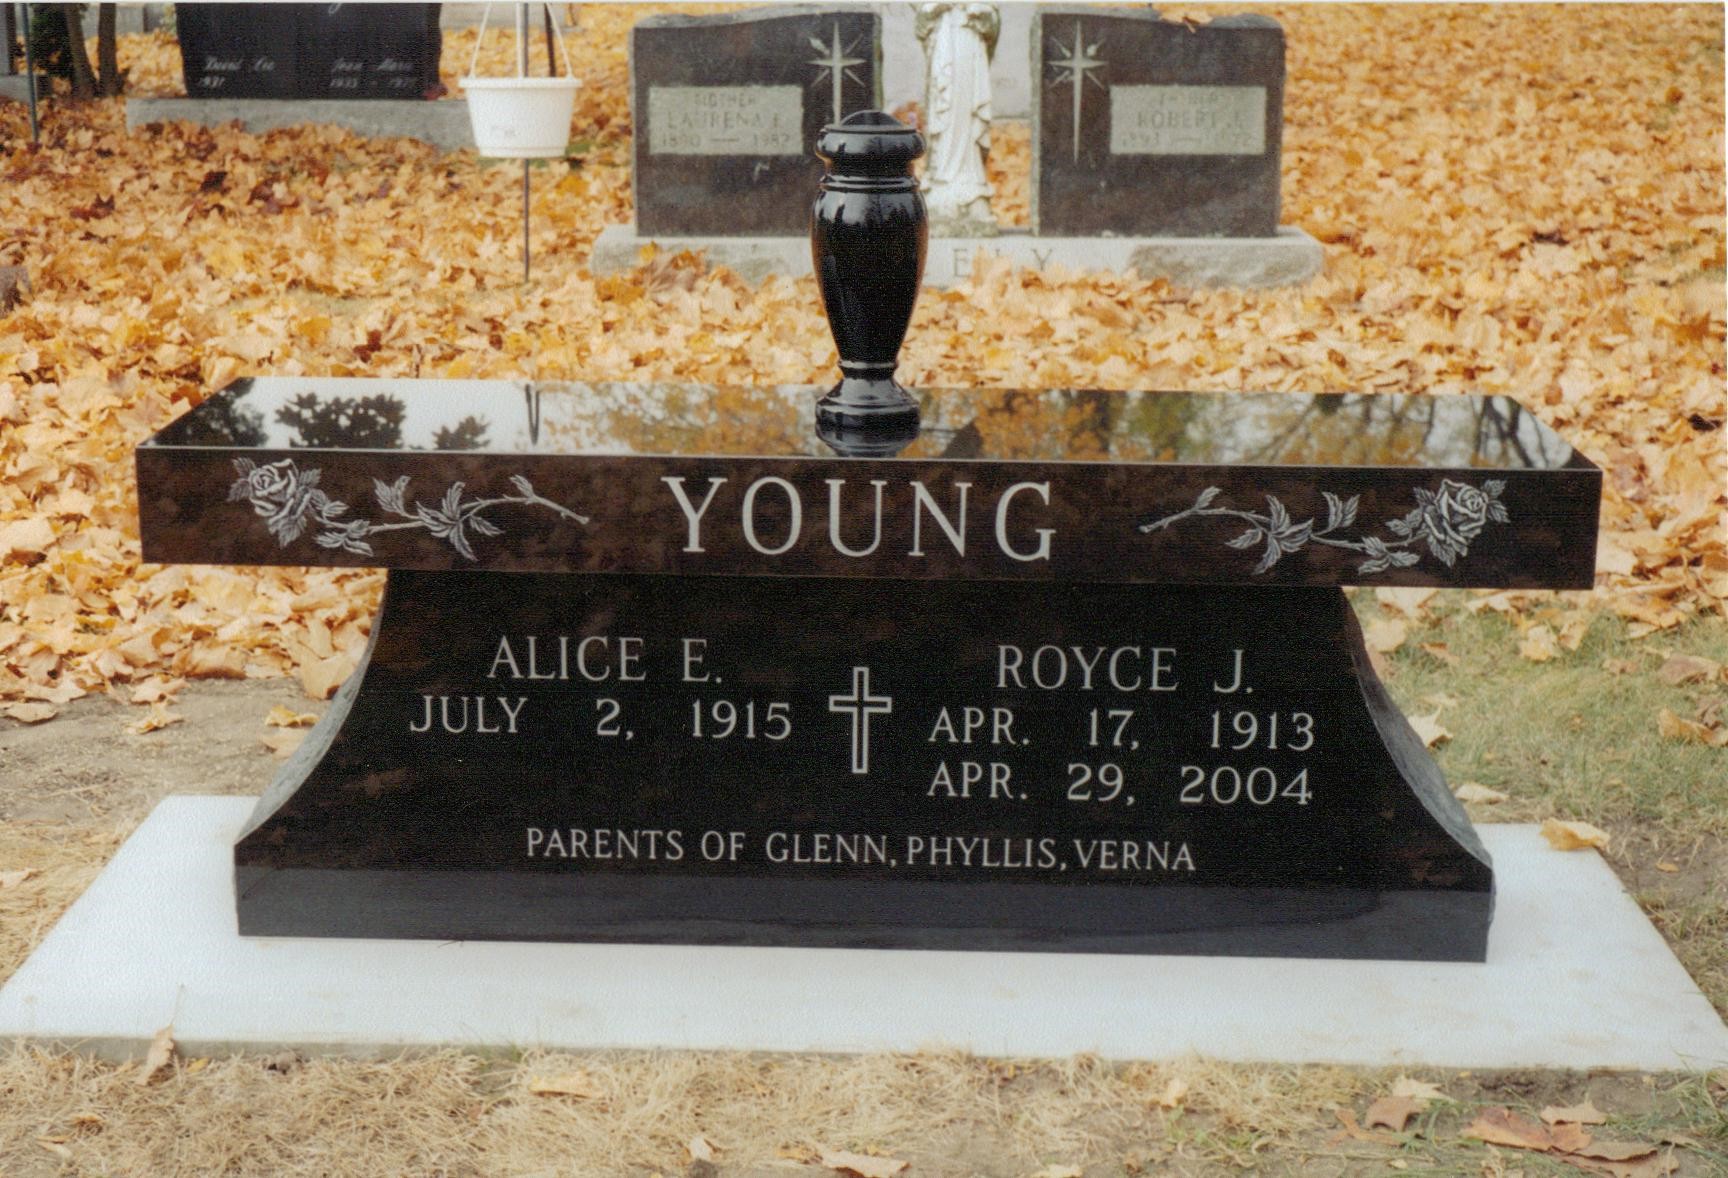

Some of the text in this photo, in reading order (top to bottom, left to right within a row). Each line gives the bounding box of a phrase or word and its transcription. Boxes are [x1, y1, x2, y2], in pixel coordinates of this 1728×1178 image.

[660, 476, 1057, 562] YOUNG
[487, 636, 723, 684] ALICE E.
[997, 645, 1253, 694] ROYCE J.
[409, 694, 792, 740] JULY 2, 1915
[928, 706, 1315, 751] APR. 17, 1913
[927, 761, 1313, 806] APR. 29, 2004
[526, 828, 1197, 871] PARENTS OF GLENN, PHYLLIS, VERNA
